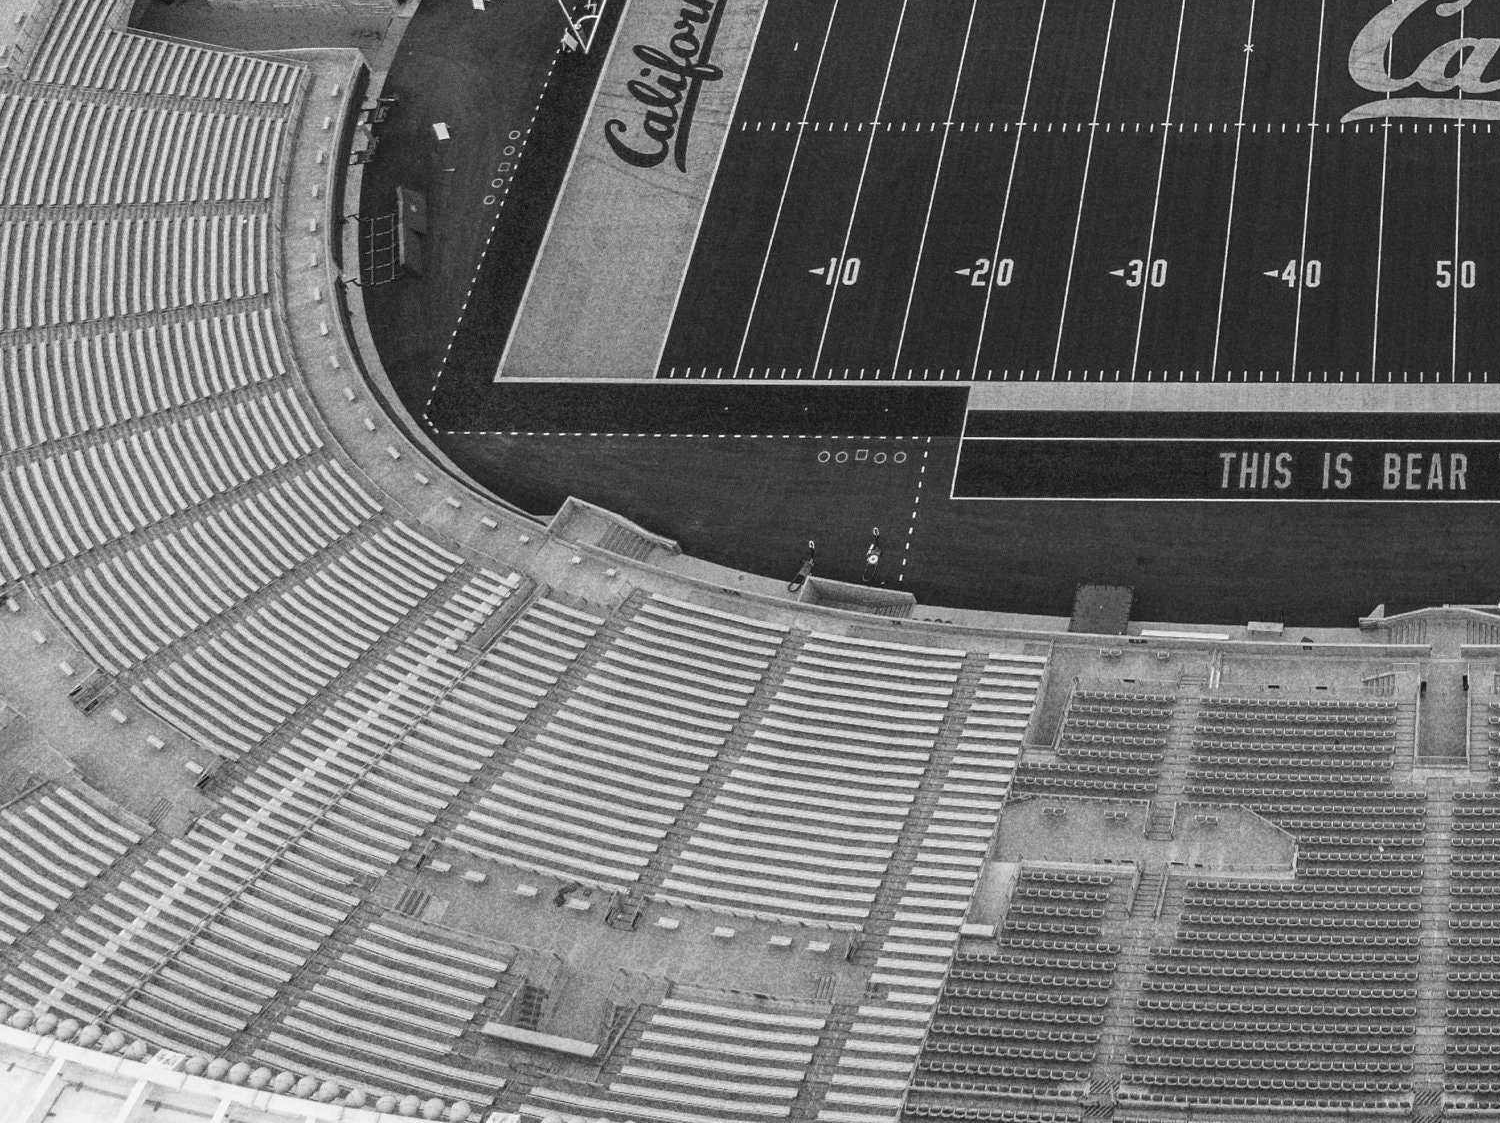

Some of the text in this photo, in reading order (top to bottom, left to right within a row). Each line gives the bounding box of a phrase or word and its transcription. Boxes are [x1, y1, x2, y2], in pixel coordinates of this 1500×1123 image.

[825, 257, 861, 286] 10
[972, 258, 1014, 287] 20
[1125, 259, 1168, 287] 30
[1281, 259, 1322, 288] 40
[1436, 260, 1475, 288] 50
[1219, 452, 1293, 489] THIS
[1322, 452, 1353, 489] IS
[1383, 453, 1468, 490] BEAR
